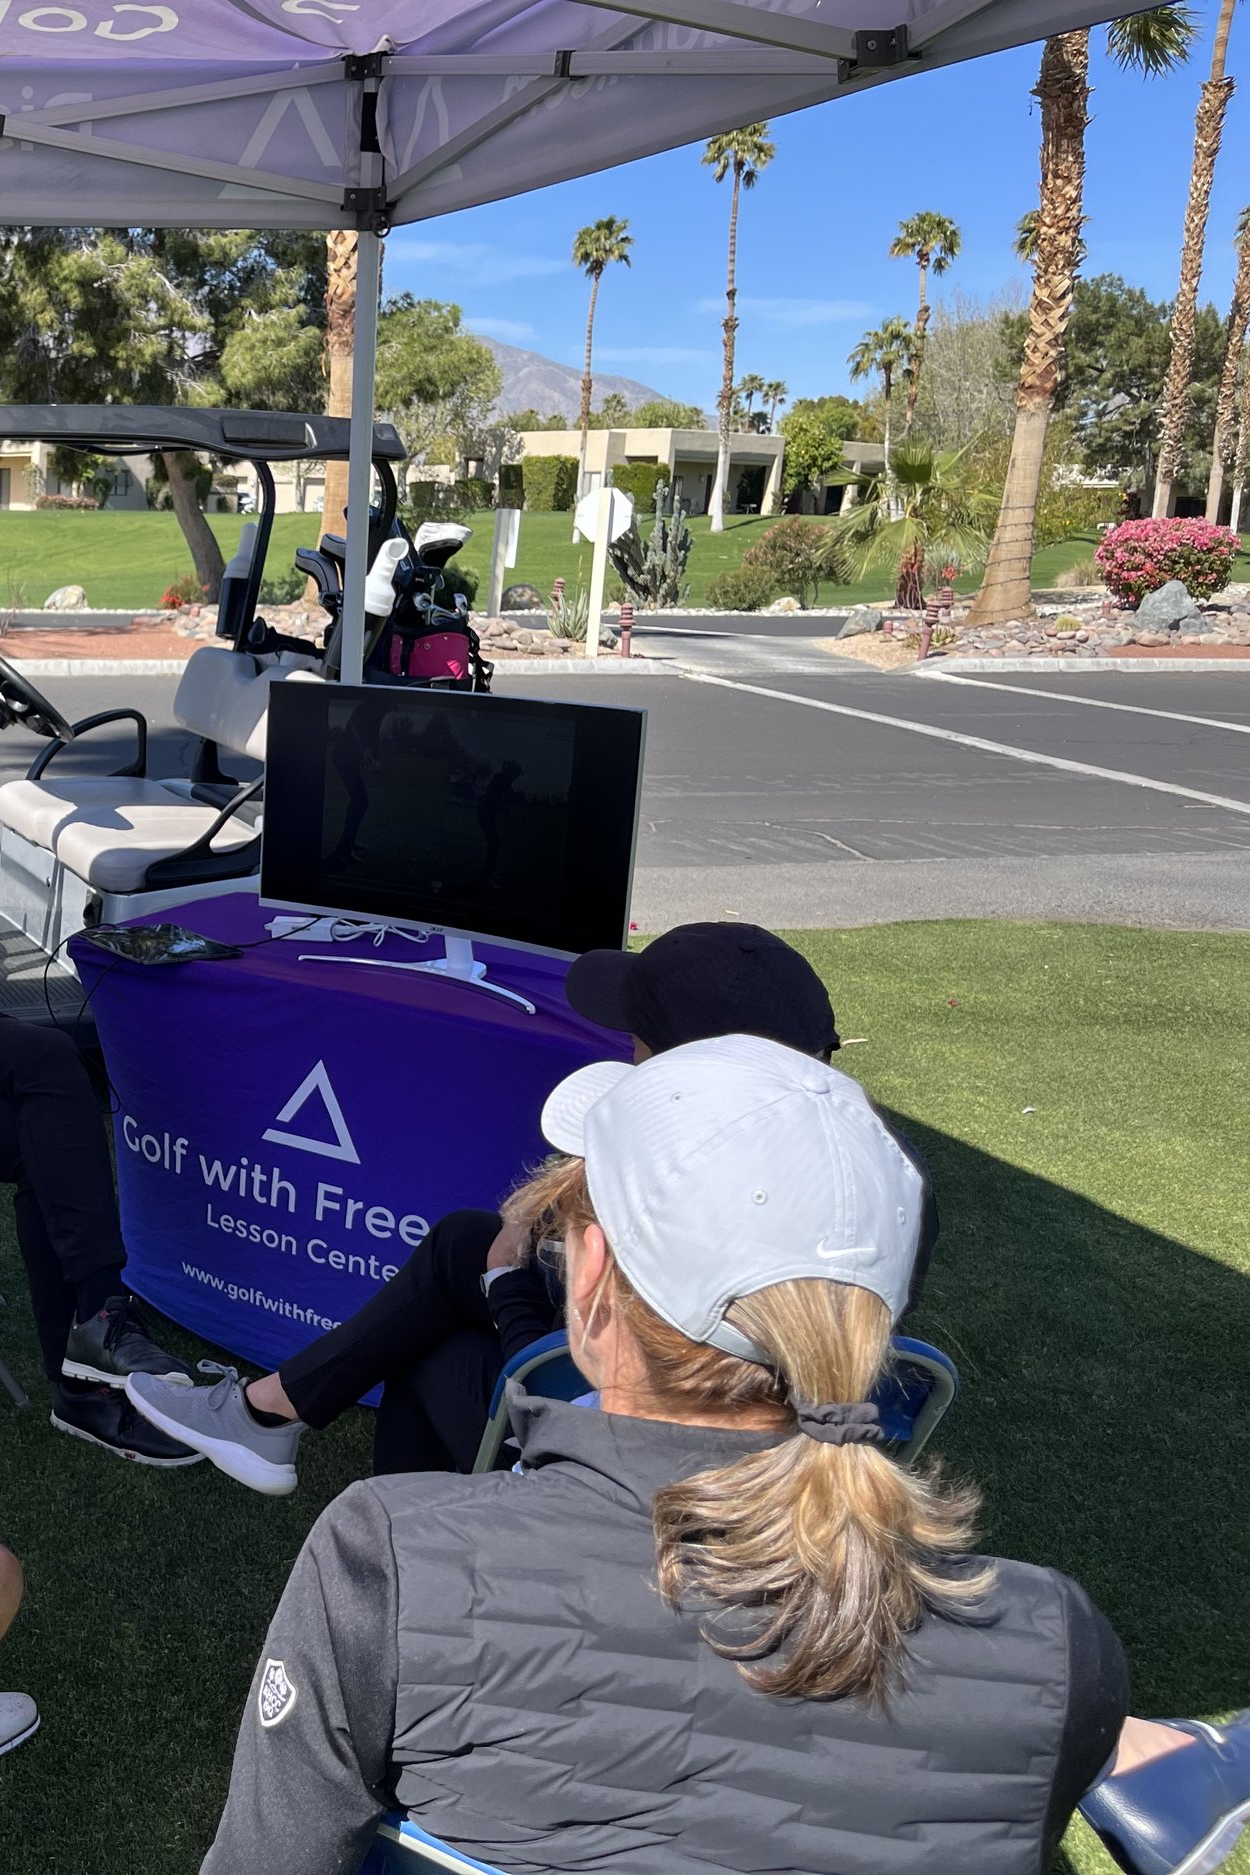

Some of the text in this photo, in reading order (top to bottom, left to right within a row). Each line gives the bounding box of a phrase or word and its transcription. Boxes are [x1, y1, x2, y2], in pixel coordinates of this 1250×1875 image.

[123, 1115, 189, 1174] Golf
[199, 1154, 297, 1213] with
[207, 1204, 297, 1255] Lesson
